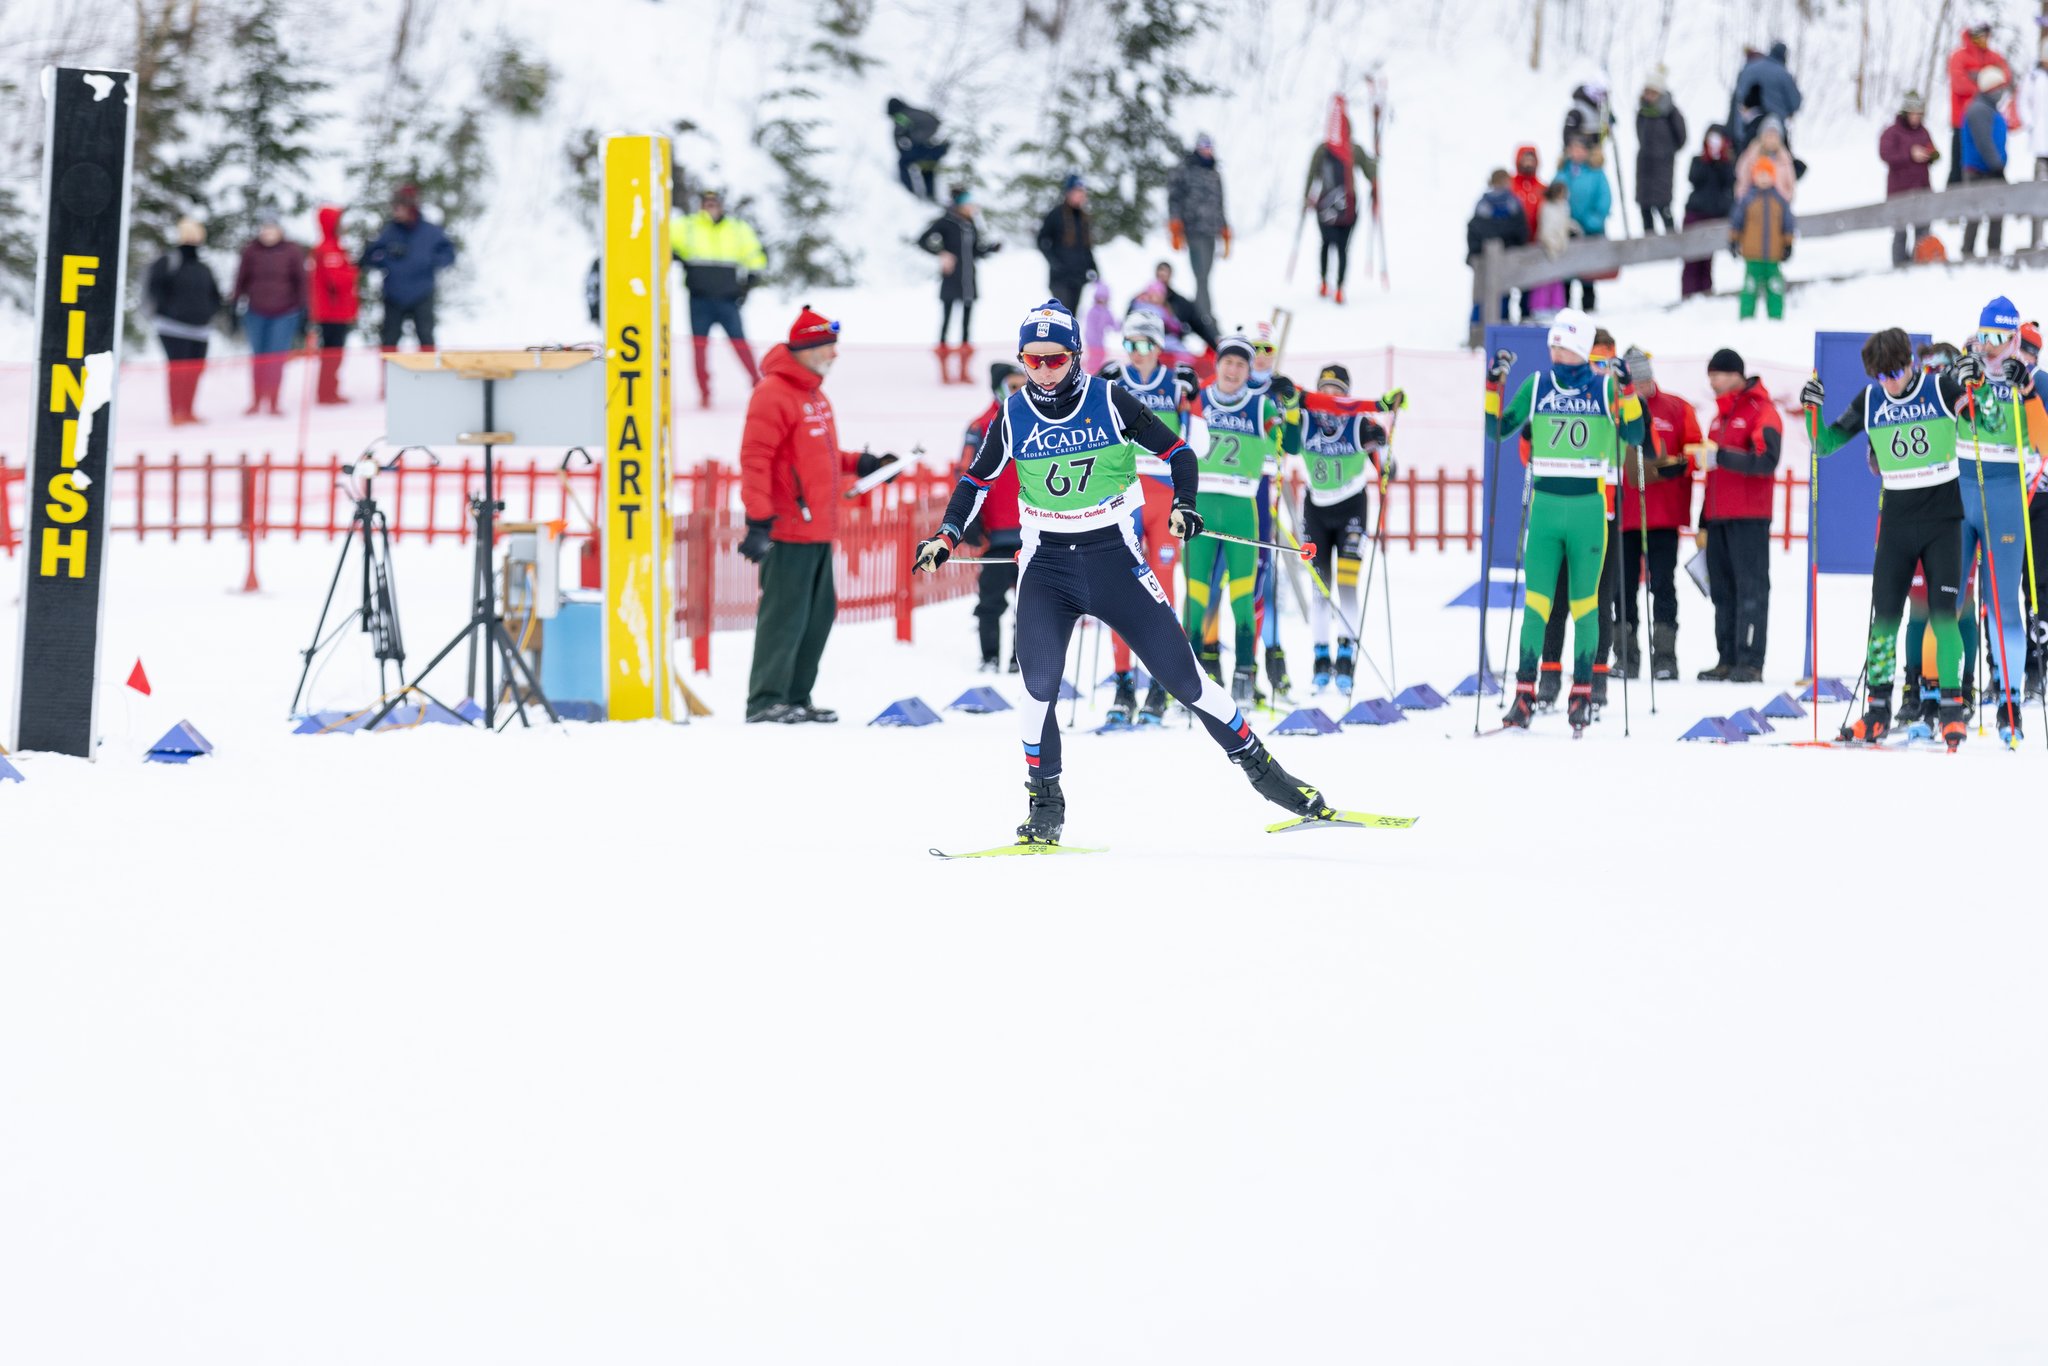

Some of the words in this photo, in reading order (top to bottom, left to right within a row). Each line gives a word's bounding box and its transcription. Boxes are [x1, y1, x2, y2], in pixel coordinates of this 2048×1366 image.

[40, 254, 100, 578] FINISH
[1537, 388, 1600, 412] ACADIA
[1874, 400, 1938, 425] ACADIA
[618, 325, 642, 540] START
[1021, 422, 1109, 453] ACADIA
[1055, 445, 1082, 454] CREDIT
[1087, 440, 1110, 449] UNION
[1548, 417, 1590, 451] 70
[1890, 425, 1931, 461] 68
[1203, 433, 1240, 466] 72
[1045, 455, 1098, 497] 67
[1314, 456, 1344, 485] 81
[1084, 508, 1107, 518] Center
